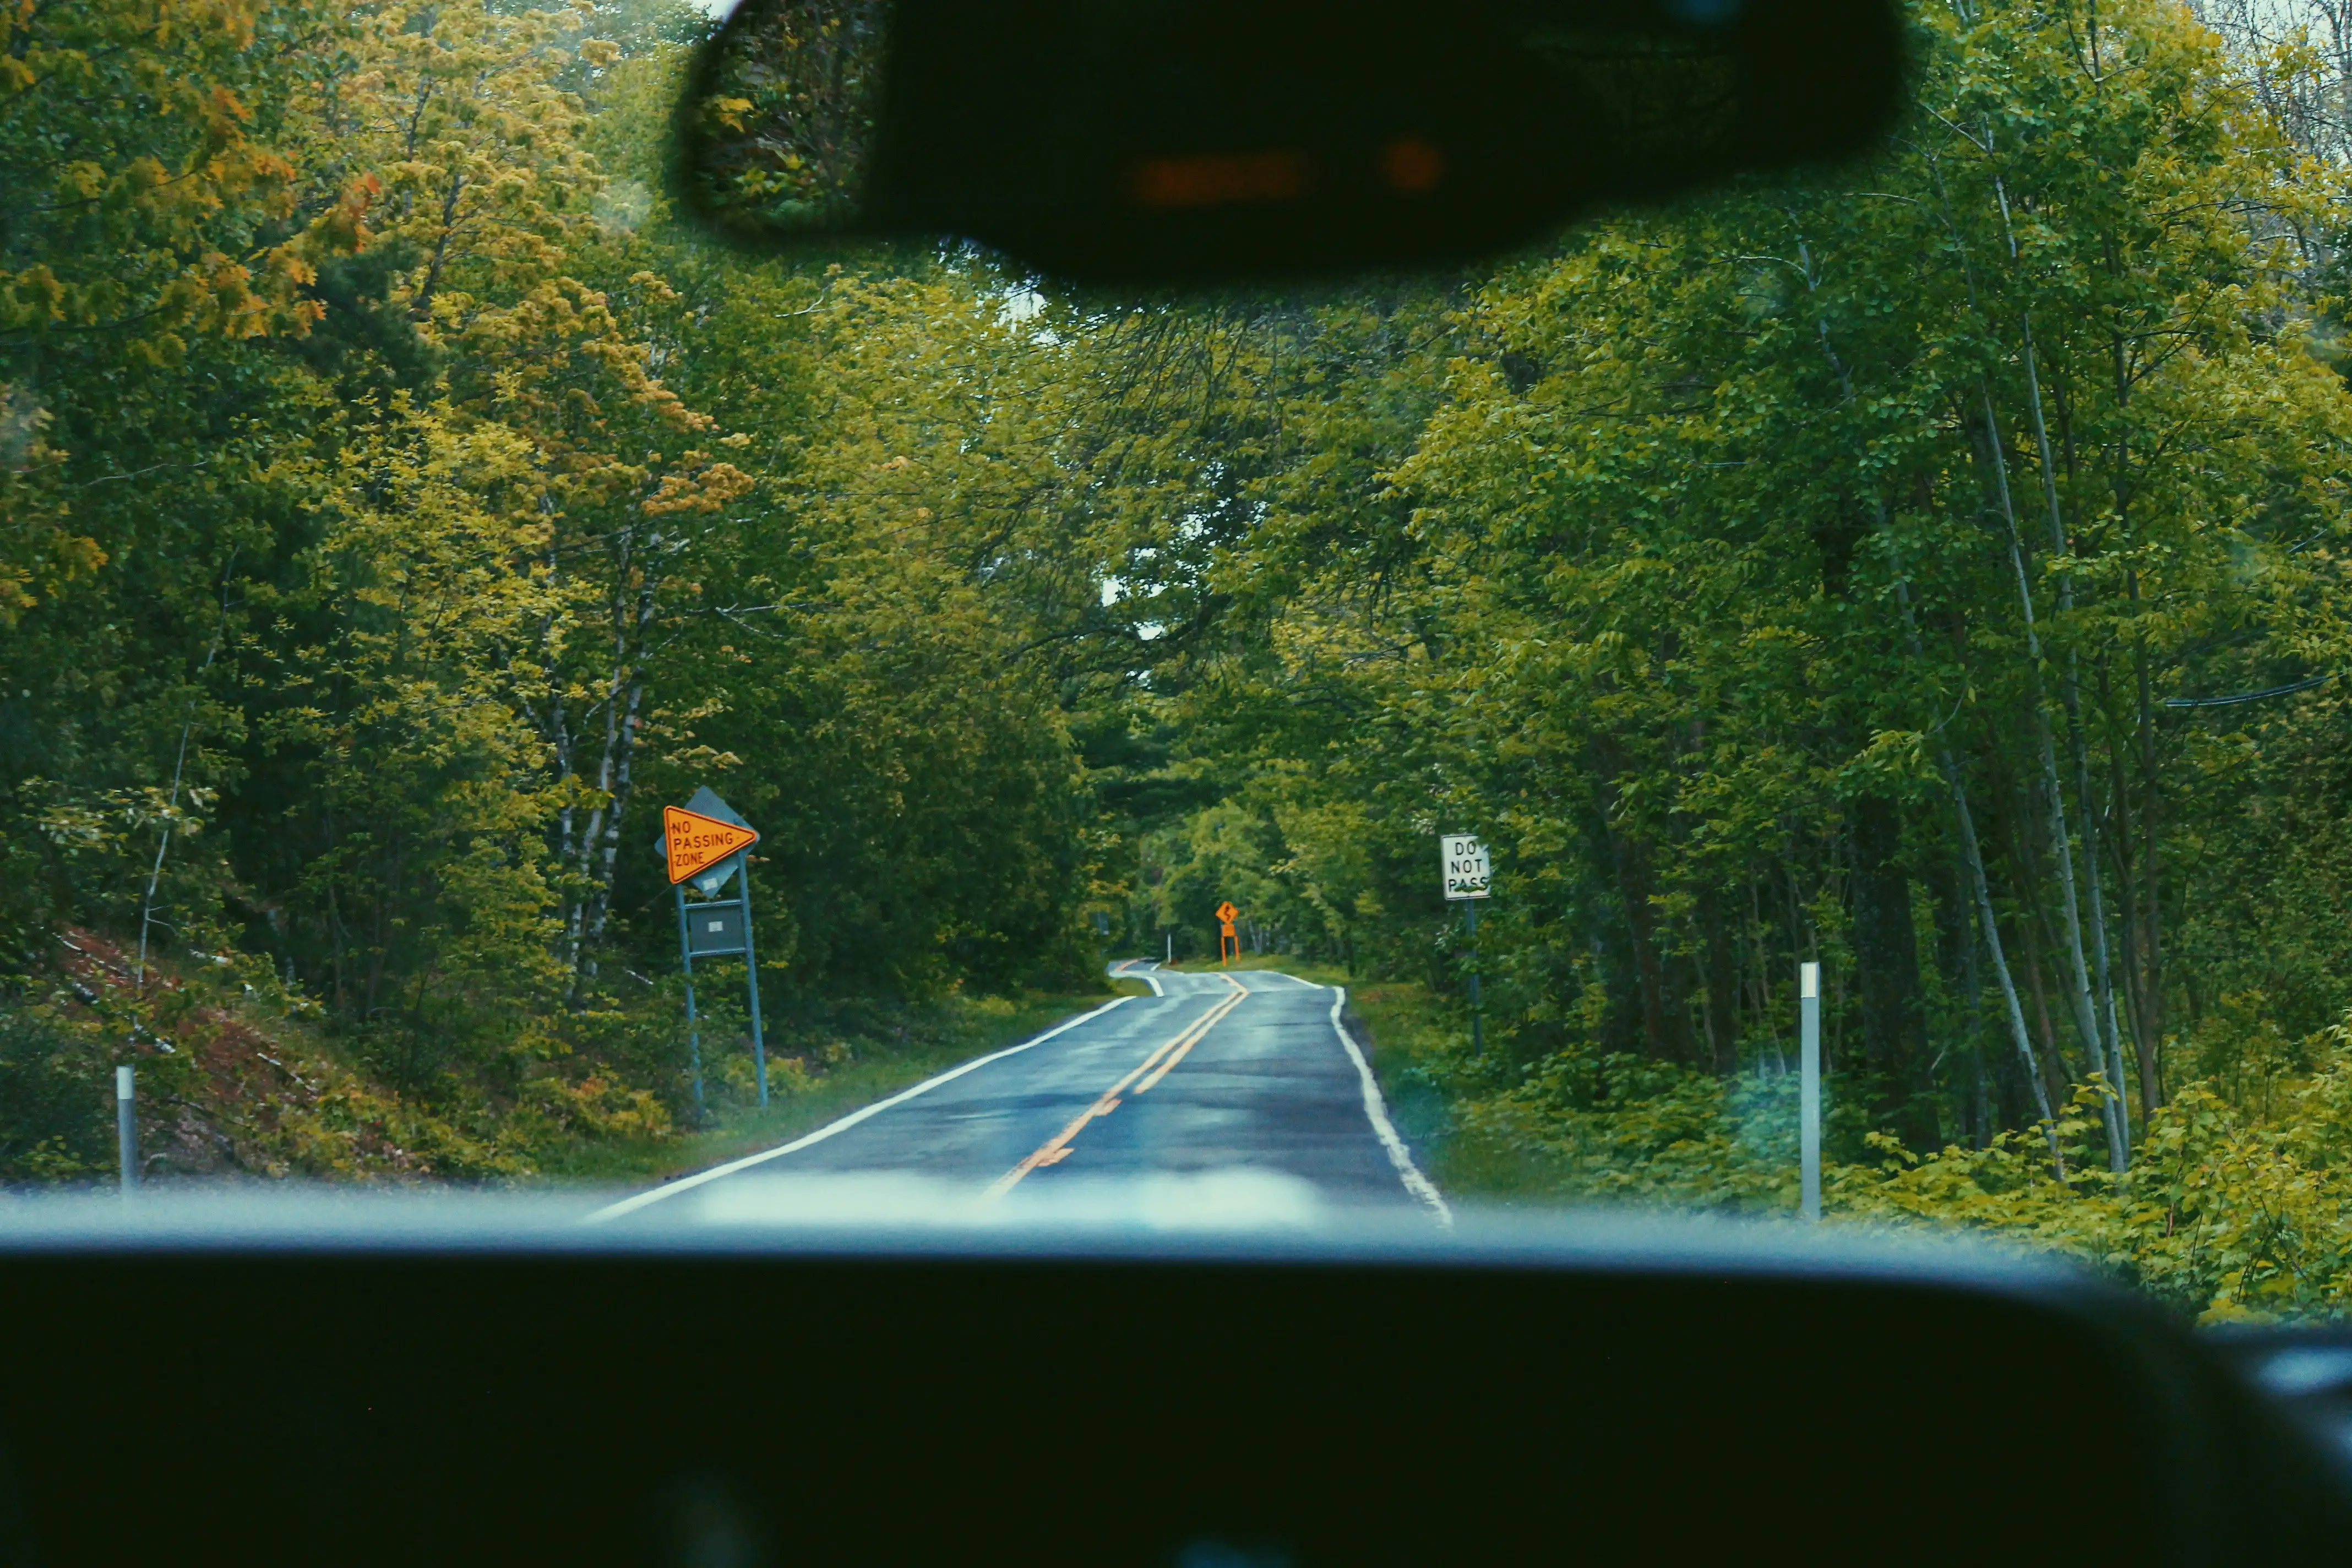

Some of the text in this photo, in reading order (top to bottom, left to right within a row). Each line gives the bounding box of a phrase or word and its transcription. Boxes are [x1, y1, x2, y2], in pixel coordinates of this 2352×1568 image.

[671, 821, 691, 834] NO
[673, 832, 733, 850] PASSING
[1455, 841, 1476, 855] DO
[676, 852, 704, 866] ZONE
[1451, 859, 1482, 874] NOT
[1448, 877, 1488, 892] PASS
